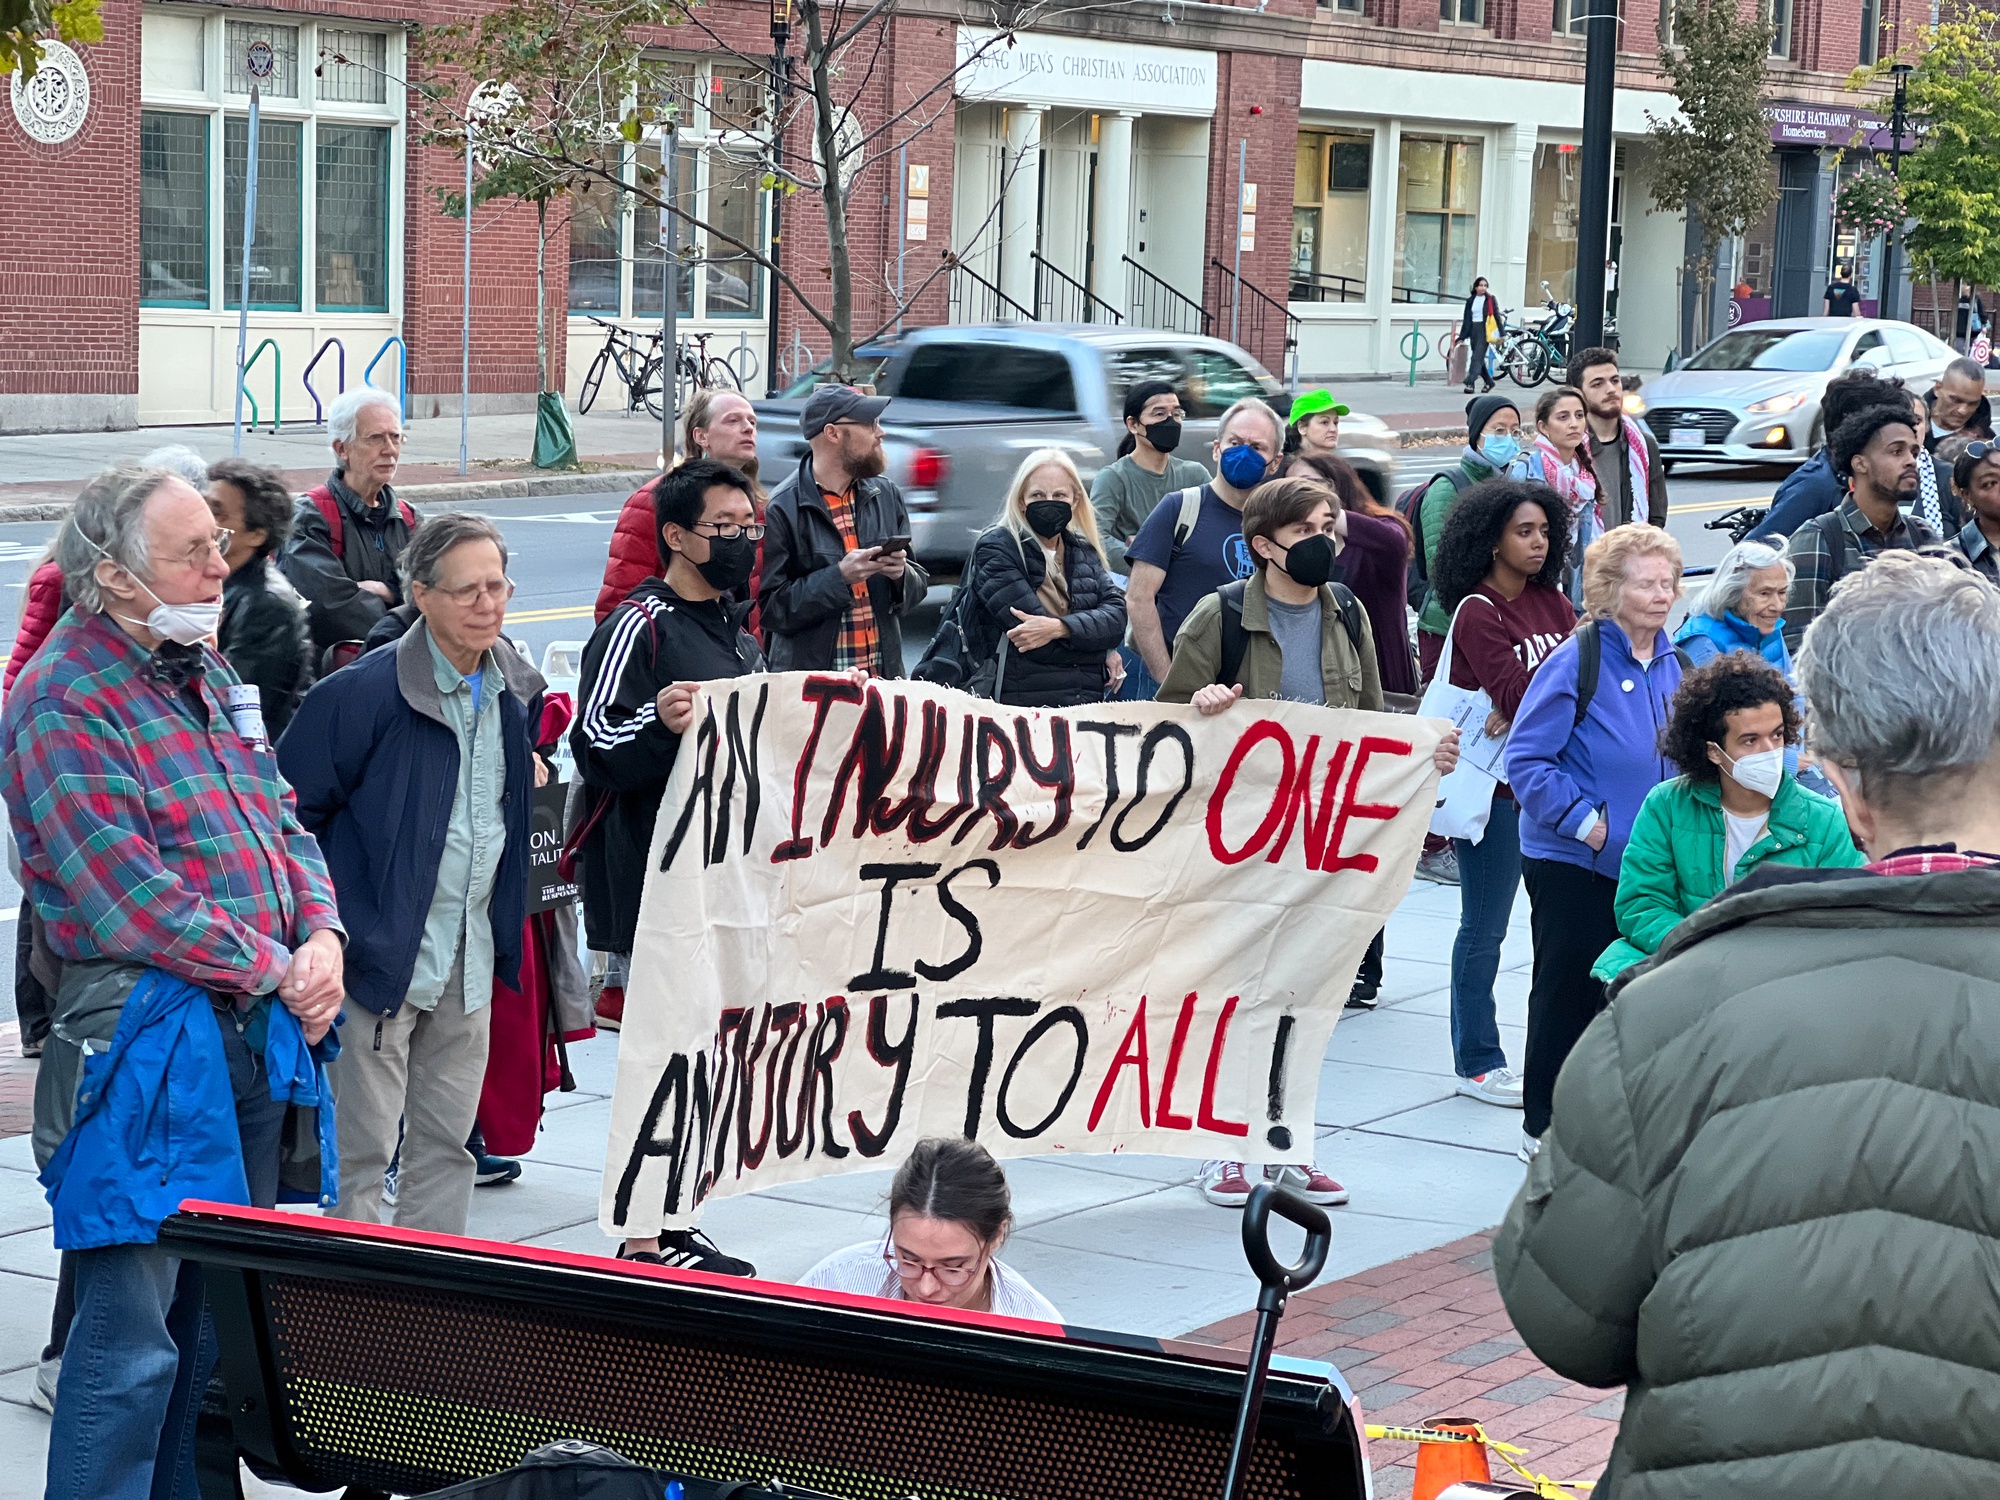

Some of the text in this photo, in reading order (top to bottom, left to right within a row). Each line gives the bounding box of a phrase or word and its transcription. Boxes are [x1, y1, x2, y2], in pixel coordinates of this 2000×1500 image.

[1063, 56, 1126, 80] CHRISTIAN
[1133, 63, 1206, 86] ASSOCIATION
[1782, 124, 1826, 138] HomeServices
[1807, 111, 1851, 127] HATHAWAY
[660, 675, 1413, 873] AN INJURY TO ONE
[846, 858, 1001, 992] IS
[613, 1034, 717, 1227] AN
[935, 996, 1090, 1142] TO
